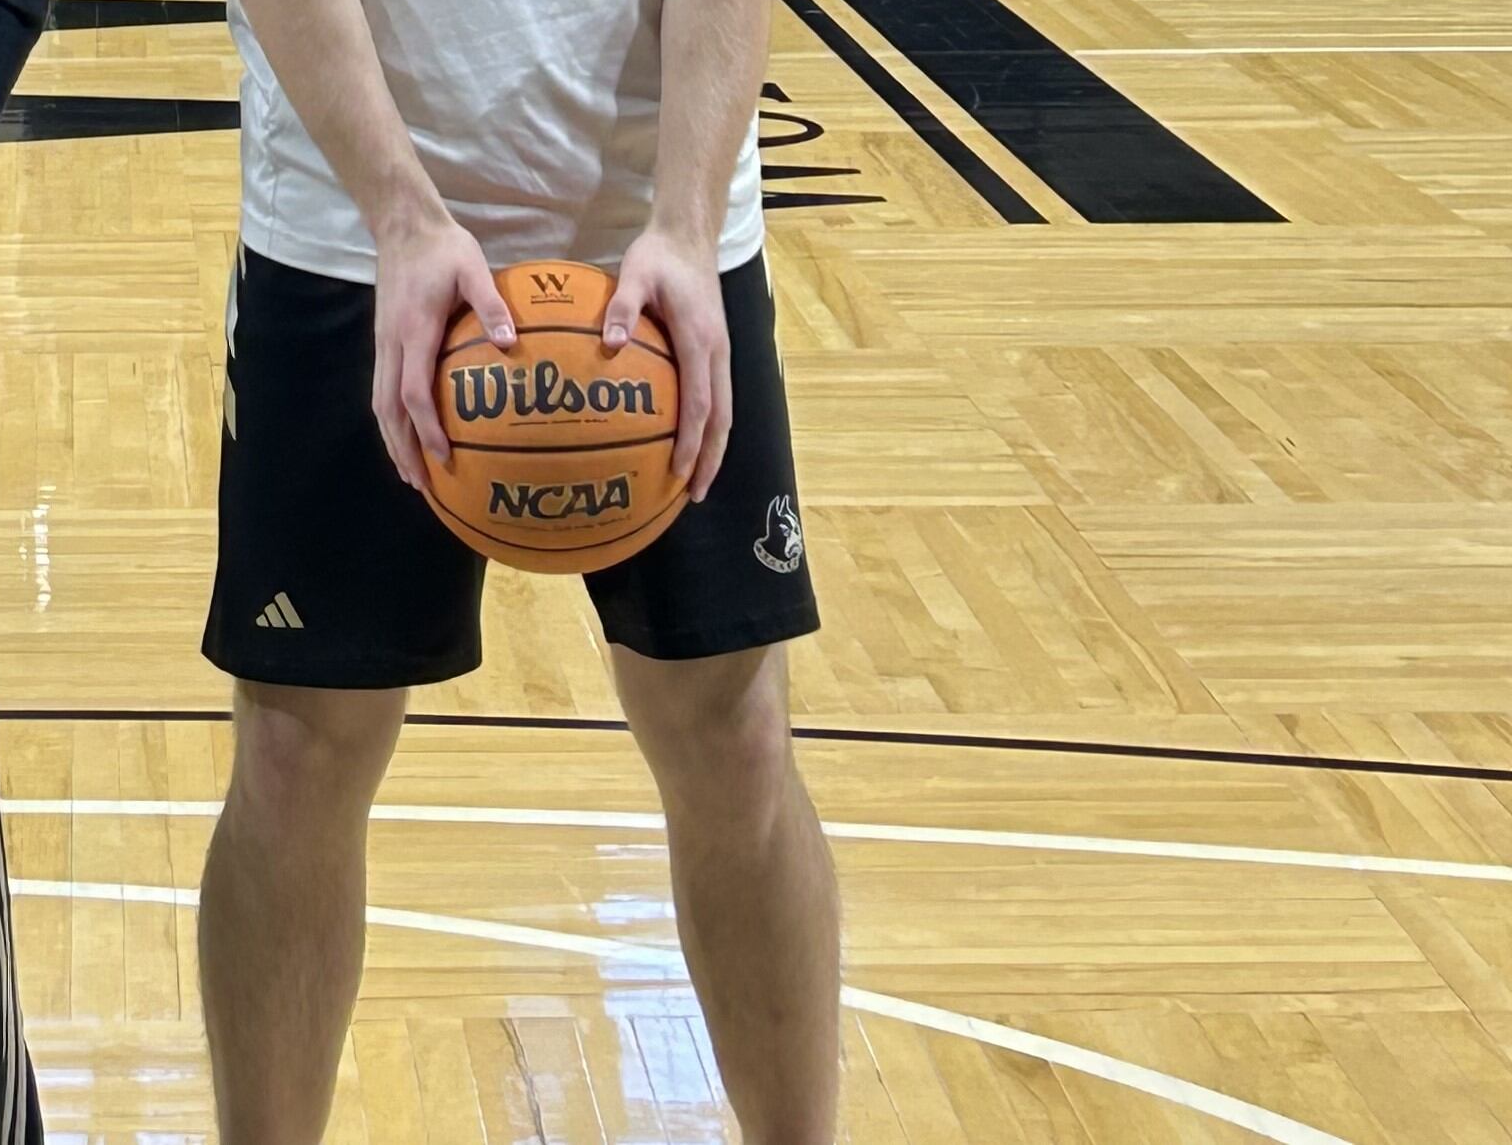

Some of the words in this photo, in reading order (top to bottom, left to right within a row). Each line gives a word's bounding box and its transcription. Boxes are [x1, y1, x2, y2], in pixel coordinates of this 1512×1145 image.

[530, 273, 570, 294] W
[449, 359, 657, 422] Wilson
[489, 474, 631, 520] NCAA
